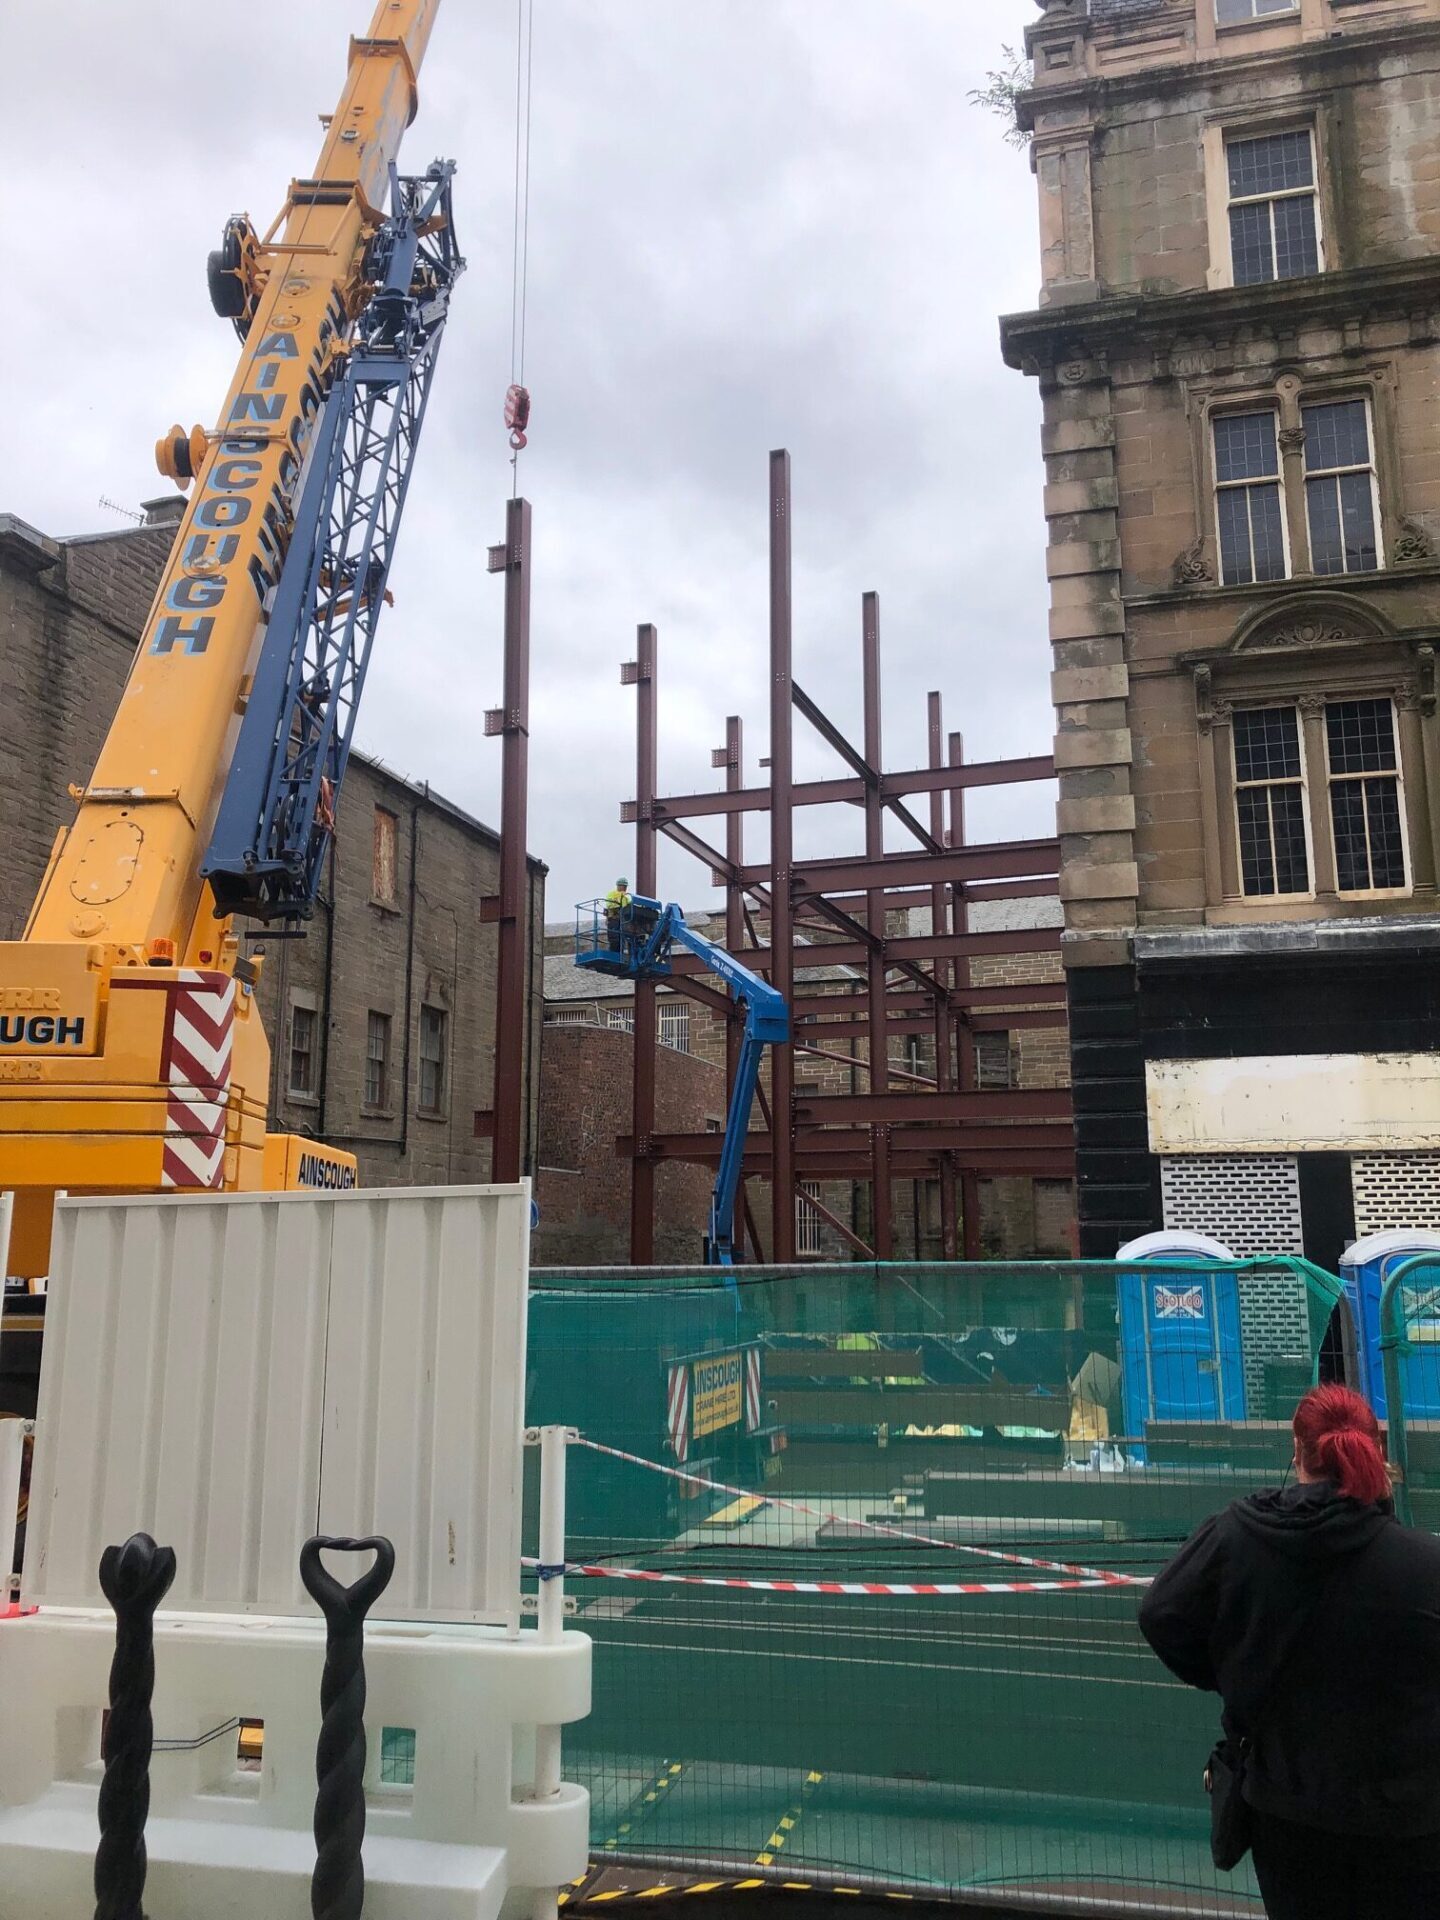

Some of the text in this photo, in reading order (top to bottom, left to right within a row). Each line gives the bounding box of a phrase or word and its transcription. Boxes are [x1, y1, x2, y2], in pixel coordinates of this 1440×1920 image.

[150, 331, 300, 655] AINSCOUGH
[0, 1015, 85, 1046] UGH
[298, 1153, 357, 1190] AINSCOUGH
[1156, 1294, 1202, 1308] SCOTLOO
